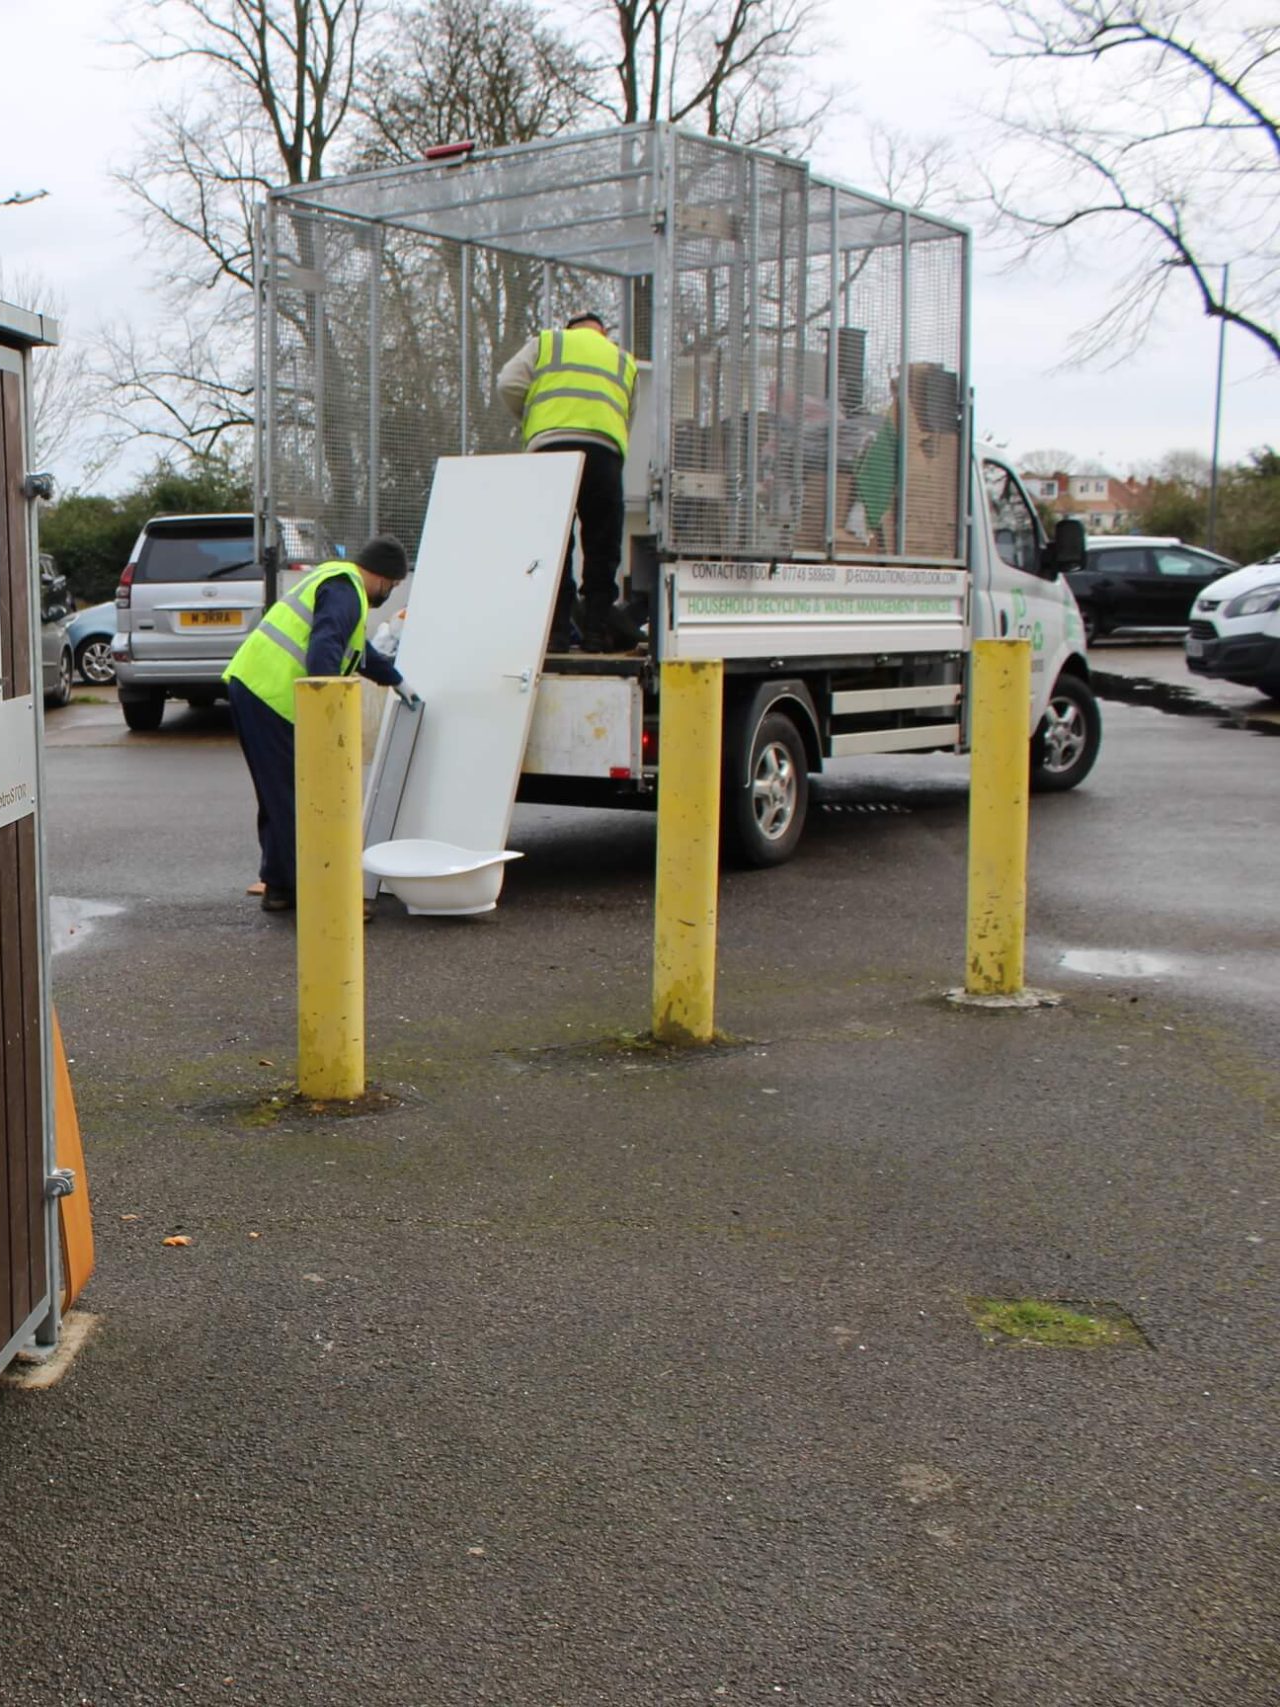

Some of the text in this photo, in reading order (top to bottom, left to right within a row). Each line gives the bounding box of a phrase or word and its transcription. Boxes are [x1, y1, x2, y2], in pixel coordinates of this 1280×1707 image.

[692, 563, 734, 579] CONTACT
[736, 564, 748, 579] US
[687, 596, 754, 614] HOUSEHOLD
[757, 597, 811, 614] RECYCLING
[824, 598, 854, 613] WASTE
[857, 599, 915, 614] MANAGEMENT
[917, 599, 952, 614] SERVICES
